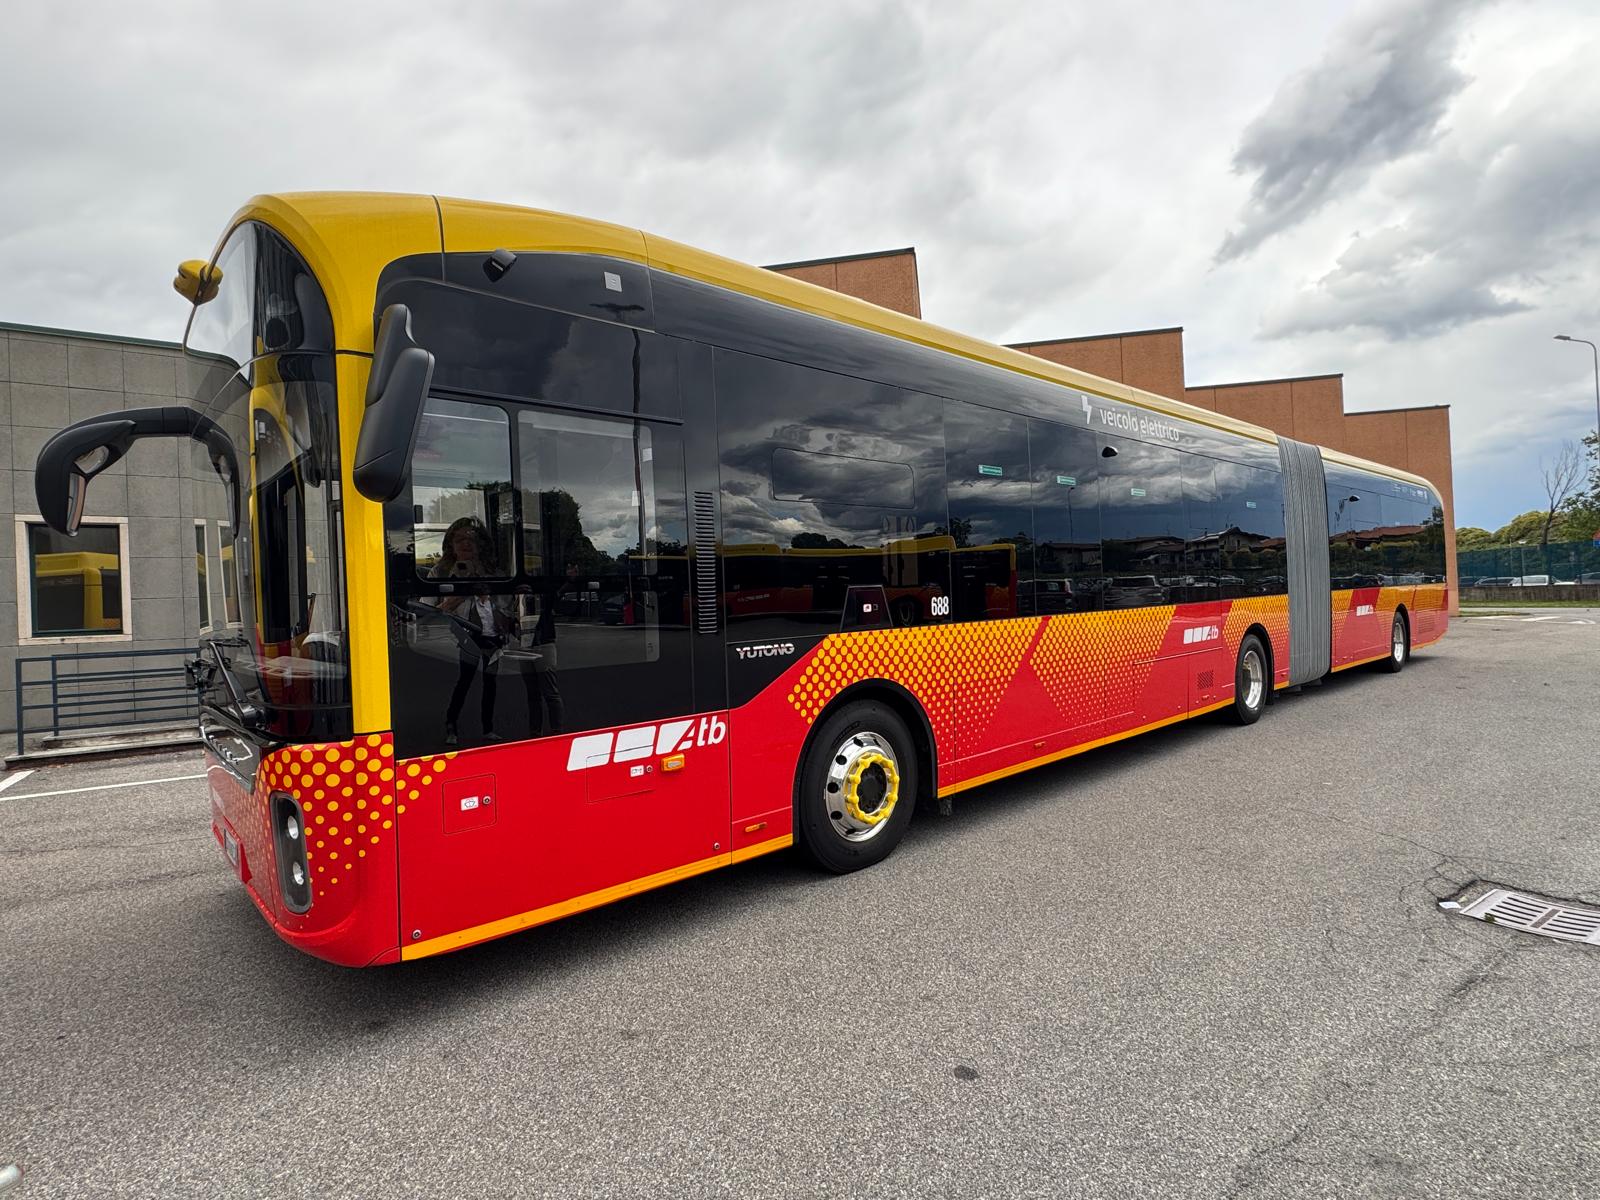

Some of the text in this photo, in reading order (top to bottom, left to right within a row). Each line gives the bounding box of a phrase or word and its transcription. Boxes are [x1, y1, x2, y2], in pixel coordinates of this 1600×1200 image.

[1100, 408, 1179, 441] veicolo elettrico
[931, 596, 949, 616] 688
[736, 643, 794, 659] YUTONG
